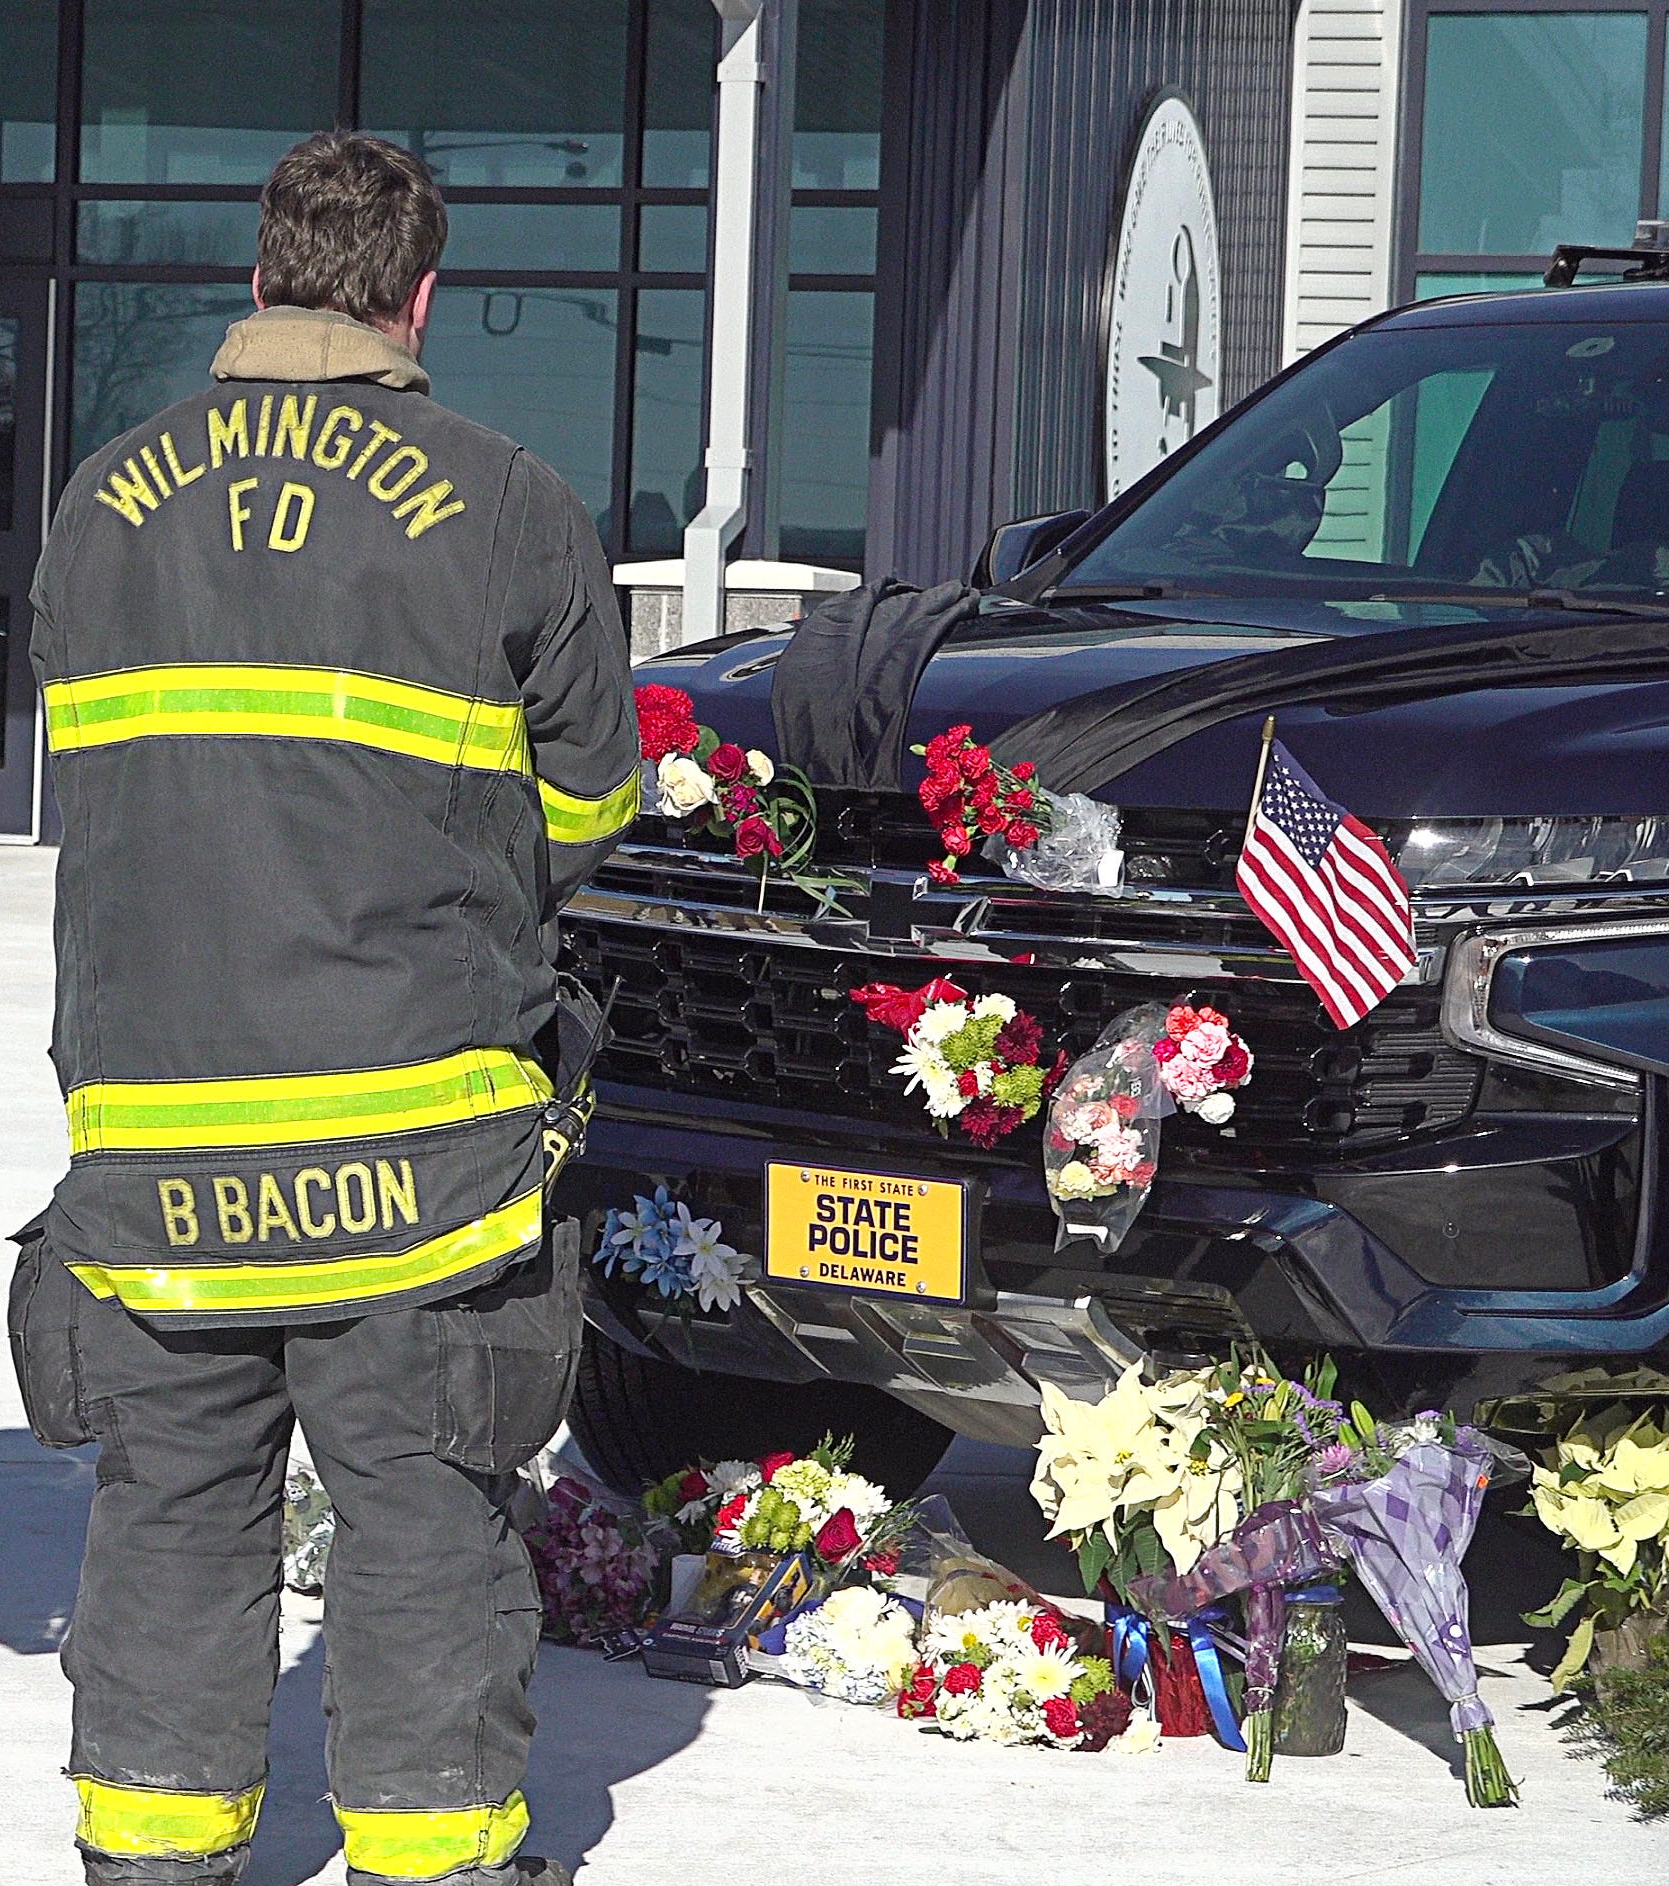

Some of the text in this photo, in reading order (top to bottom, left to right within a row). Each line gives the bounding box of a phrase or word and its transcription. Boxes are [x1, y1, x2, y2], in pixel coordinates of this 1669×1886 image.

[94, 393, 466, 541] WILMINGTON
[228, 477, 316, 553] FD
[157, 1157, 421, 1247] B BACON
[814, 1174, 914, 1197] THE FIRST STATE
[816, 1193, 911, 1233] STATE
[808, 1223, 919, 1265] POLICE
[819, 1262, 907, 1287] DELAWARE
